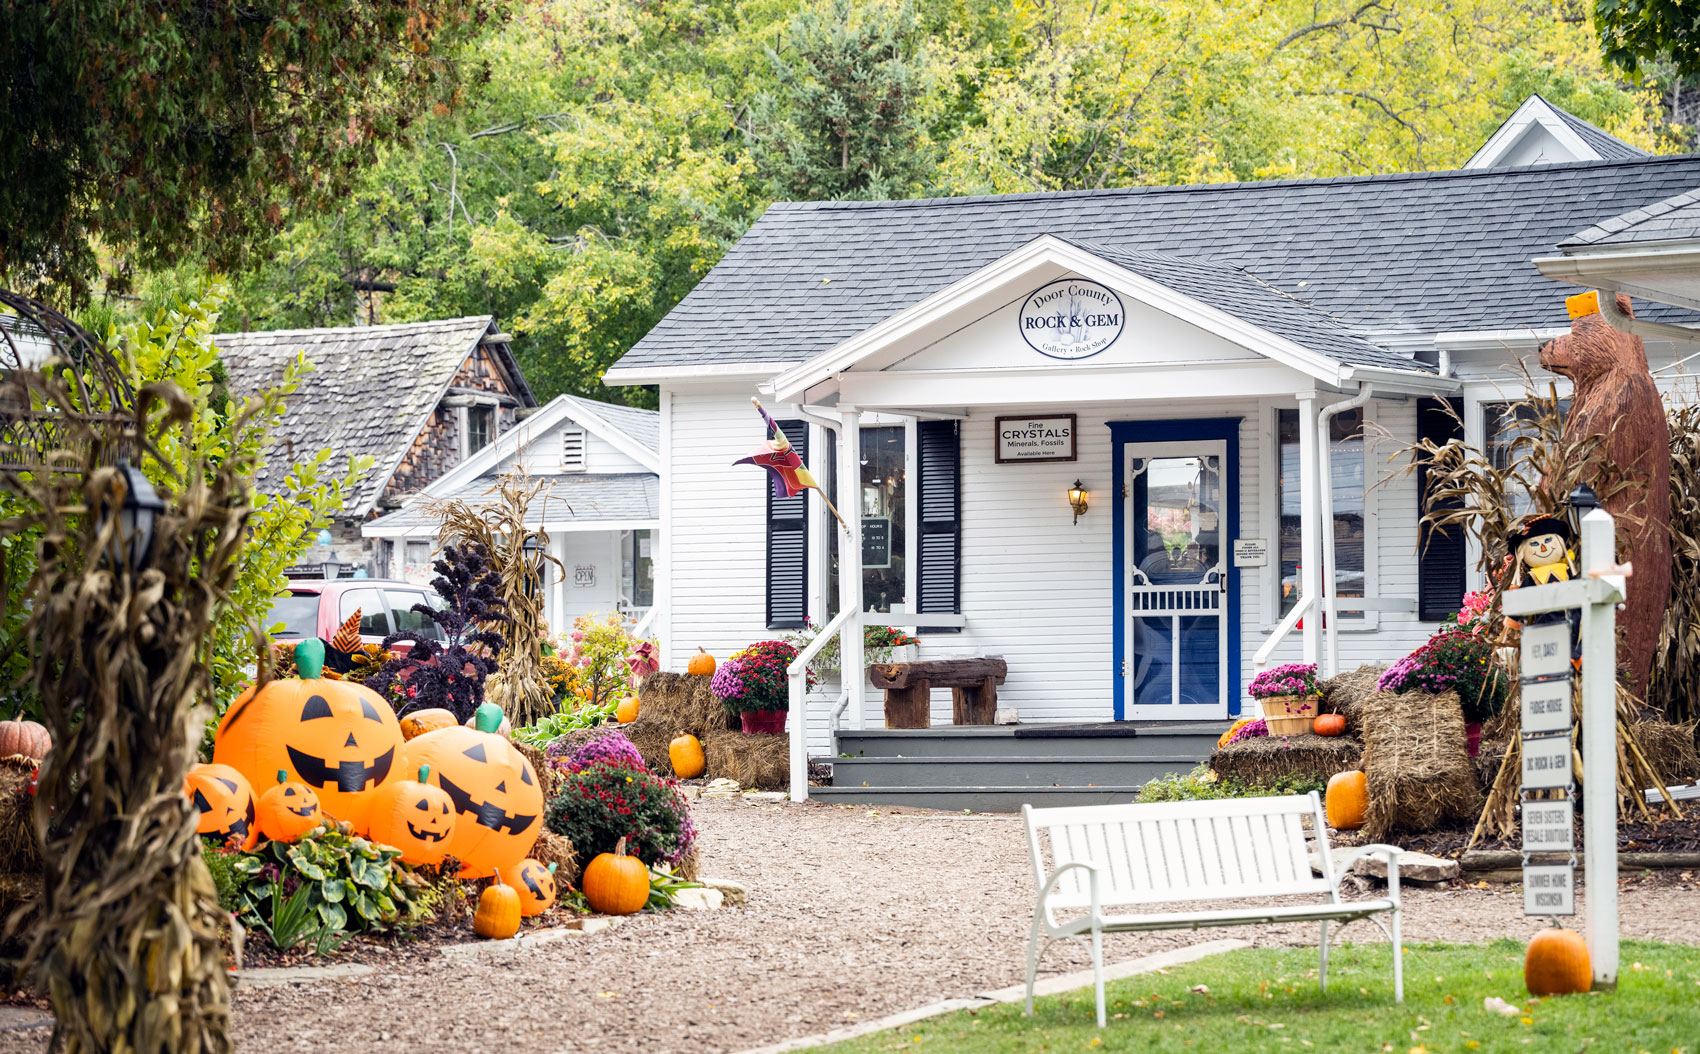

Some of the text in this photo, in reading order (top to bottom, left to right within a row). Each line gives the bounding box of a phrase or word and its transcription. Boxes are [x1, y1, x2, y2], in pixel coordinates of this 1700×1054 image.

[1033, 285, 1113, 309] Door County
[1025, 314, 1119, 329] ROCK & GEM
[1042, 337, 1107, 355] Gallery Rock Shop
[1002, 428, 1070, 439] CRYSTALS
[576, 570, 593, 582] OPEN
[1543, 642, 1559, 657] DAISY
[1529, 698, 1563, 715] FUDGE HOUSE
[1527, 754, 1566, 771] DC ROCK & GEM
[1527, 810, 1565, 824] SEVEN SISTERS
[1526, 828, 1569, 843] RESALE BOUTIQUE
[1529, 873, 1566, 888] SUMMER HOME
[1535, 892, 1563, 906] WISCONSIN
